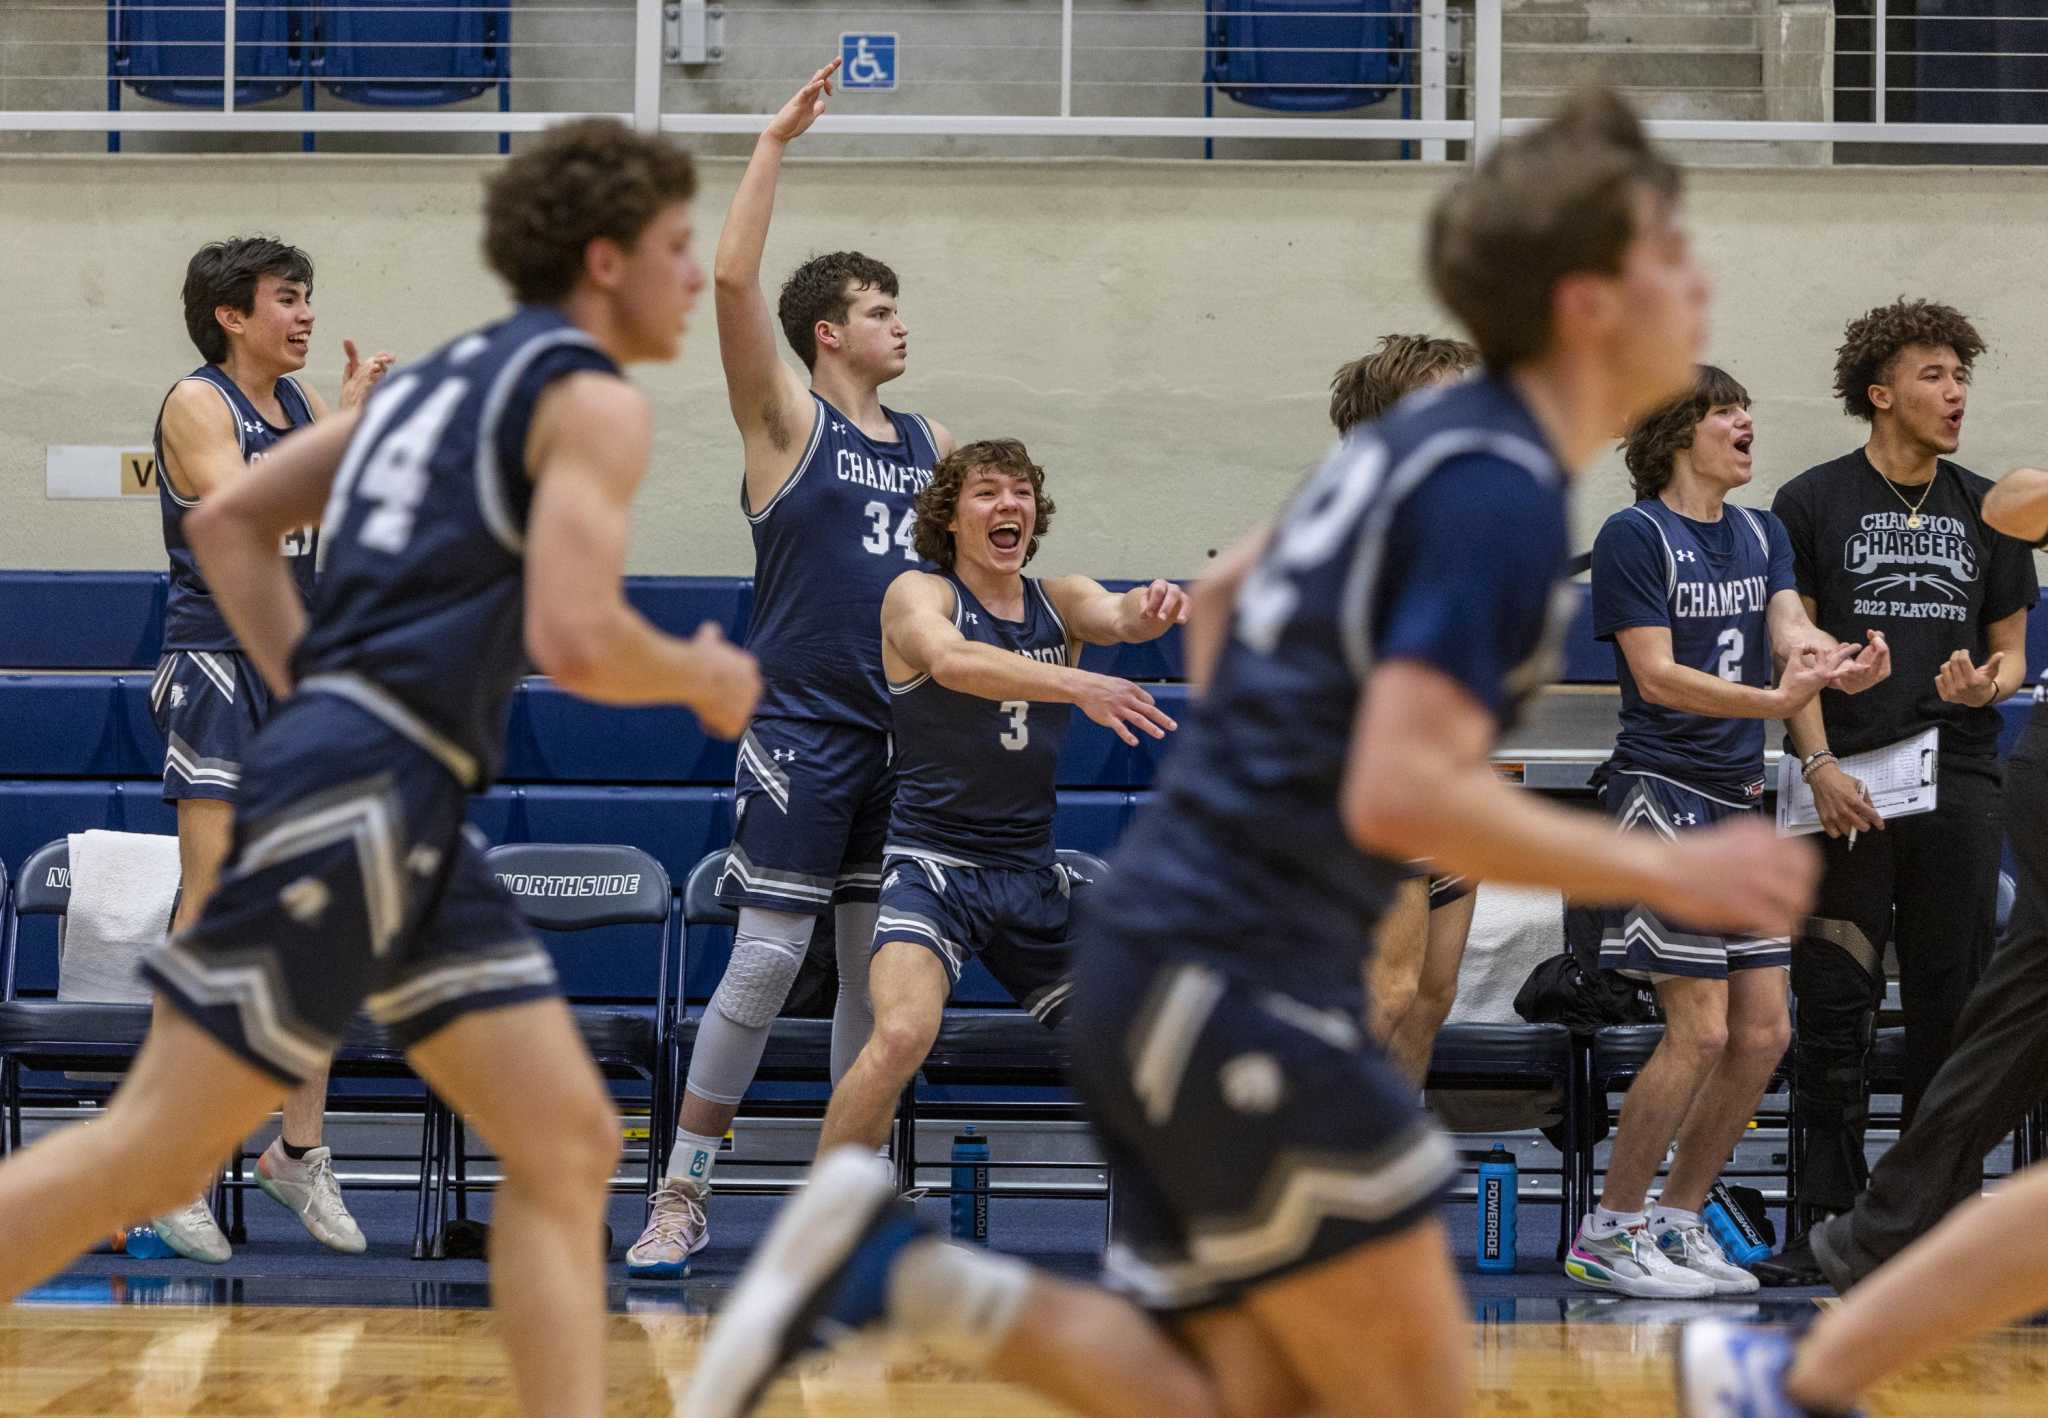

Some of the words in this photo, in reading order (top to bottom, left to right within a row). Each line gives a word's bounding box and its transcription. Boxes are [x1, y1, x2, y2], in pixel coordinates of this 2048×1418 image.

[132, 459, 160, 488] V
[862, 500, 920, 563] 34
[1844, 530, 1980, 582] CHARGERS
[1853, 599, 1887, 616] 2022
[1890, 601, 1967, 622] PLAYOFFS
[1717, 627, 1744, 683] 2
[1000, 700, 1029, 750] 3
[495, 873, 640, 897] NORTHSIDE
[1486, 1180, 1499, 1257] POWERADE
